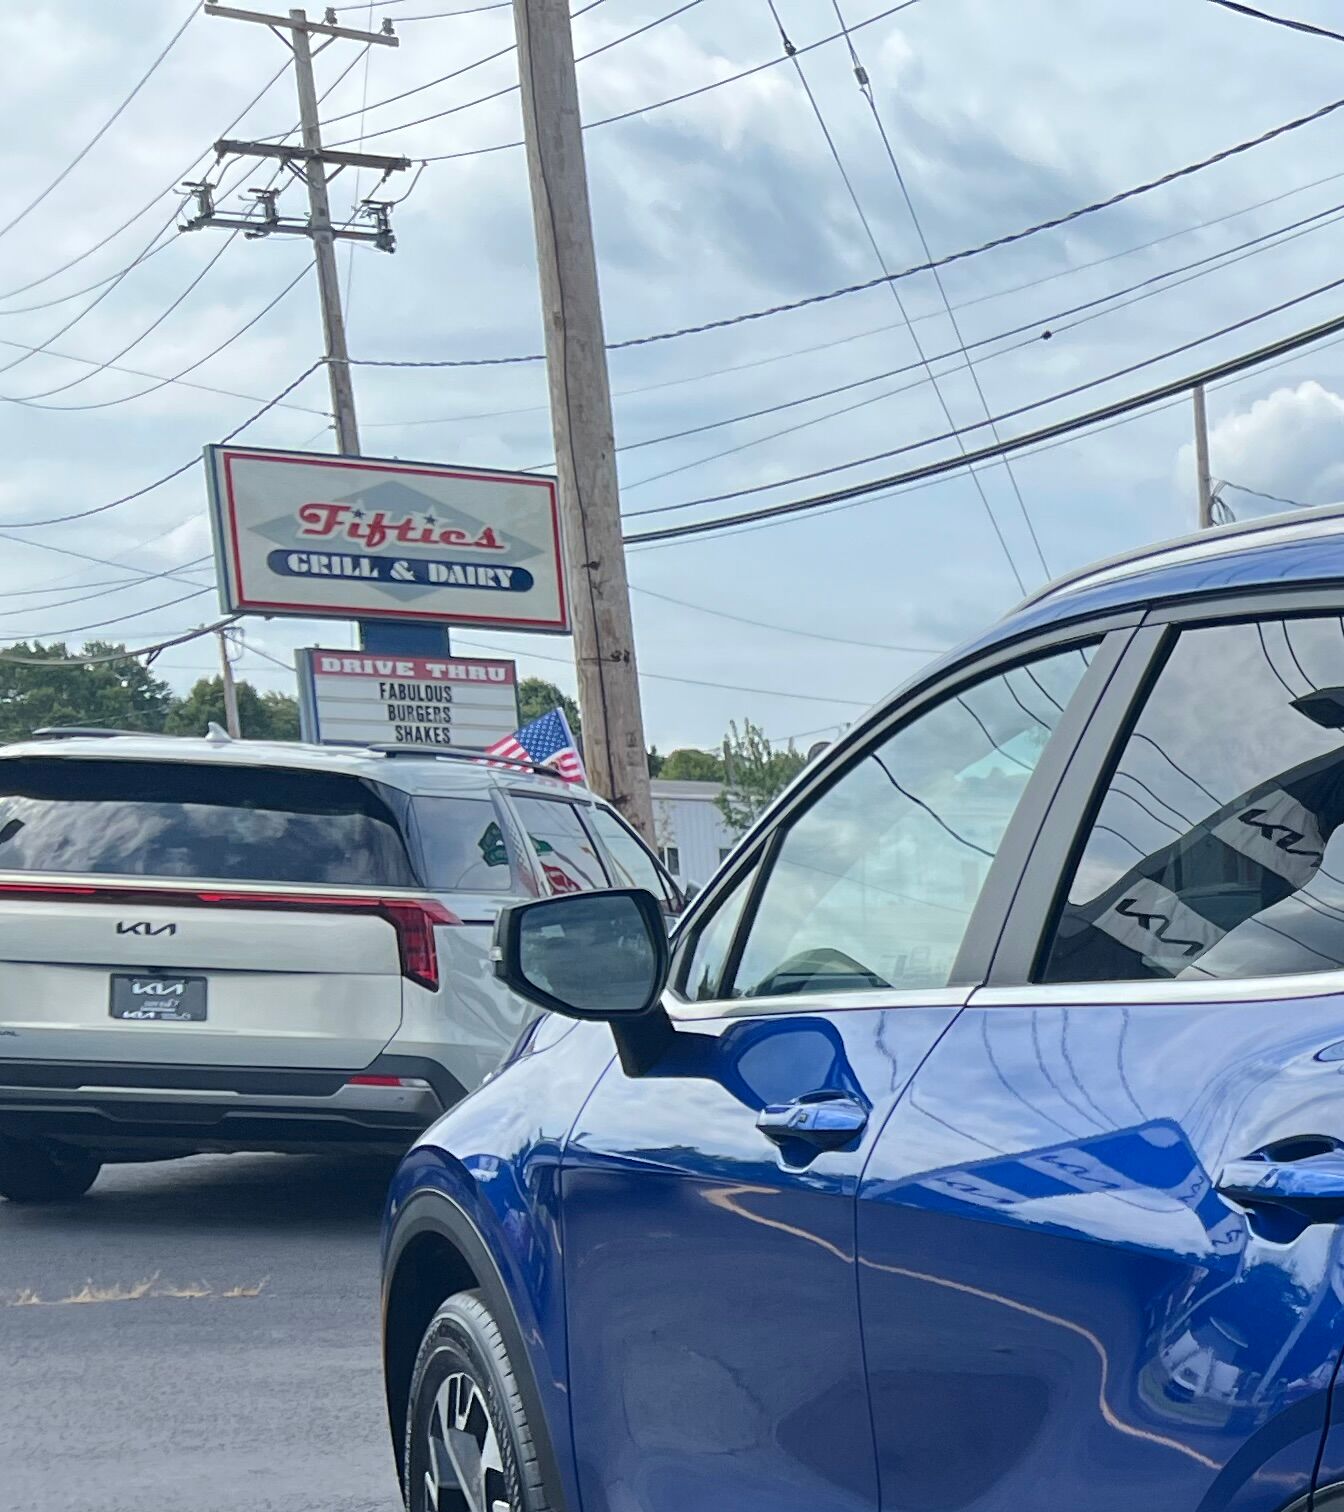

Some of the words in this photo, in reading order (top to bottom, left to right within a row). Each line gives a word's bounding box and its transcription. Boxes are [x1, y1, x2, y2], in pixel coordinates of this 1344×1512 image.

[299, 502, 506, 549] Fifties
[286, 552, 380, 579] GRILL
[389, 560, 417, 582] &
[428, 562, 514, 588] DAIRY
[320, 657, 416, 677] DRIVE
[425, 663, 506, 683] THRU
[379, 682, 453, 703] FABULOUS
[387, 704, 452, 724] BURGERS
[395, 724, 451, 745] SHAKES
[115, 920, 176, 936] KIA
[131, 982, 184, 995] KIA
